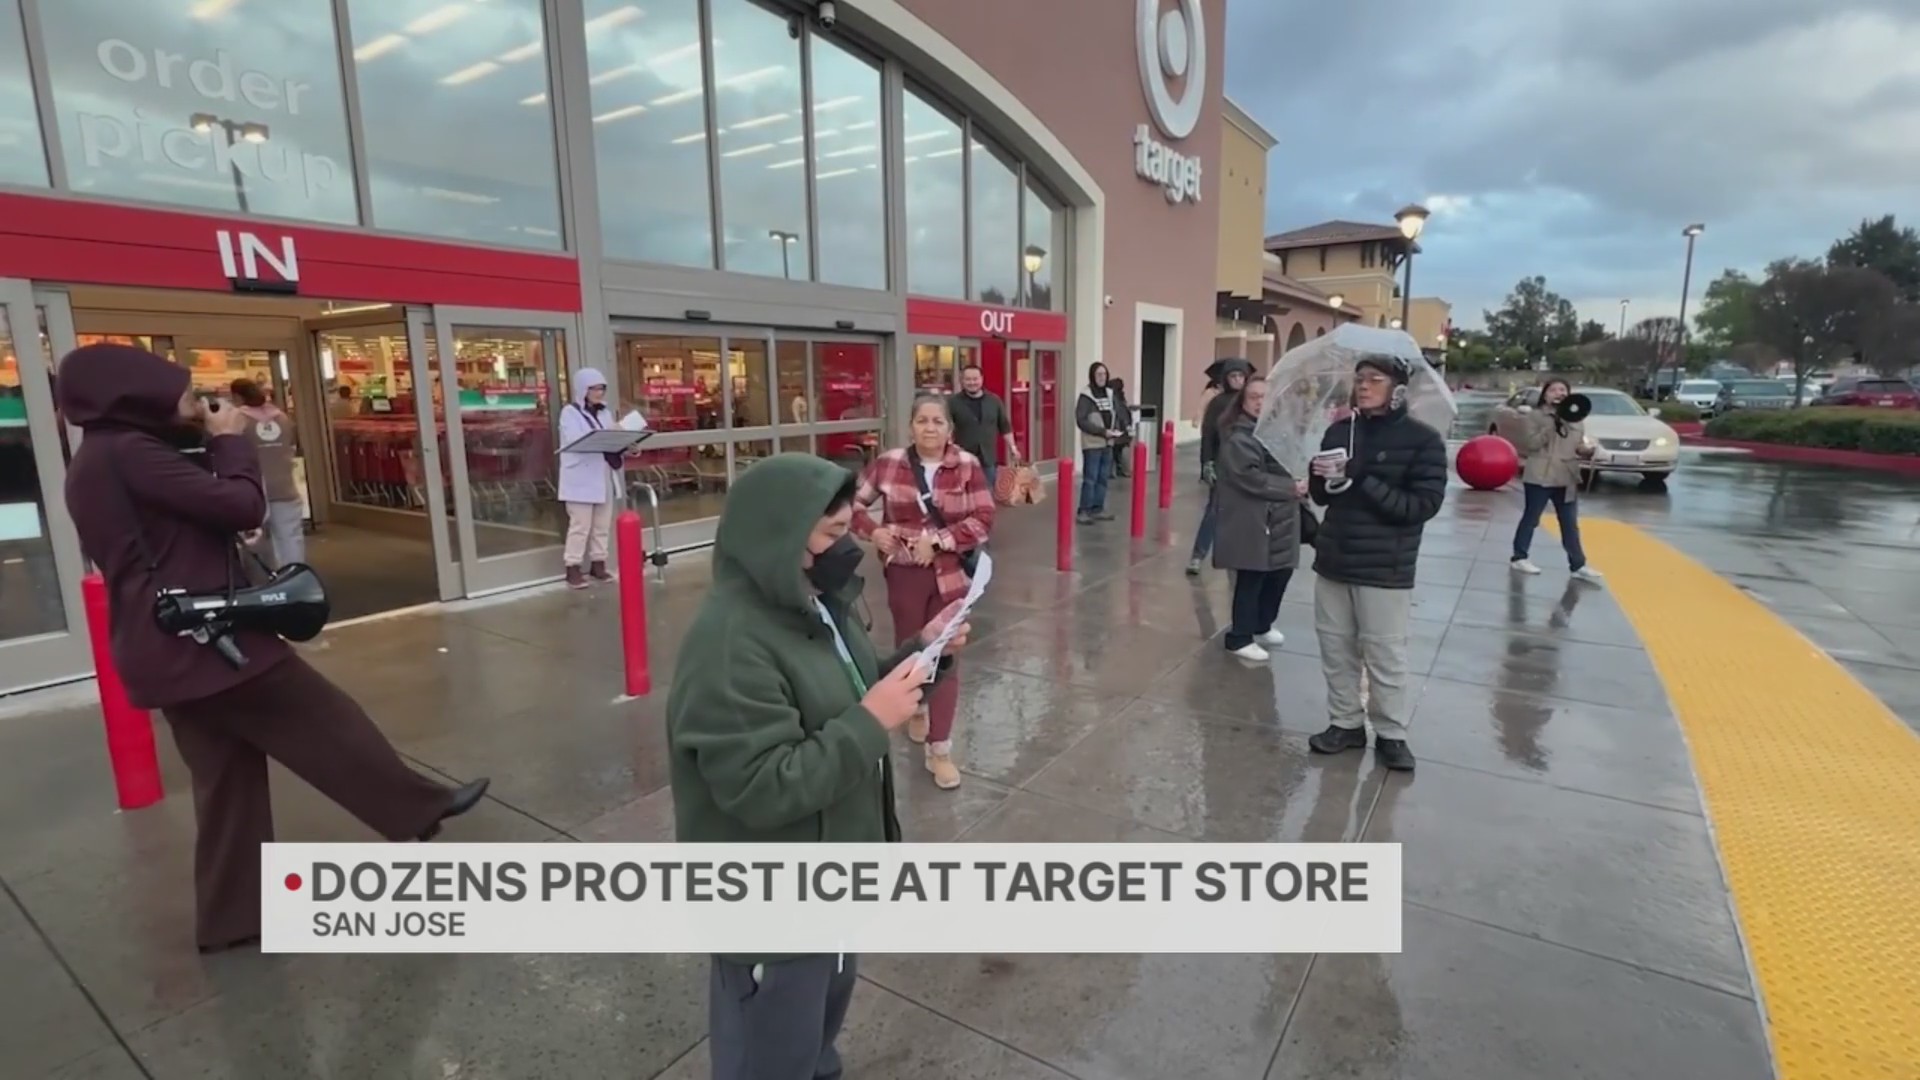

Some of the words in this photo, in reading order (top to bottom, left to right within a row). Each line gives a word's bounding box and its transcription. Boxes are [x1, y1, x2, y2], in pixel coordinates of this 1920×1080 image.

[97, 38, 310, 116] order
[77, 106, 340, 199] pickup
[1133, 123, 1202, 203] target
[216, 229, 300, 282] IN
[980, 310, 1015, 333] OUT
